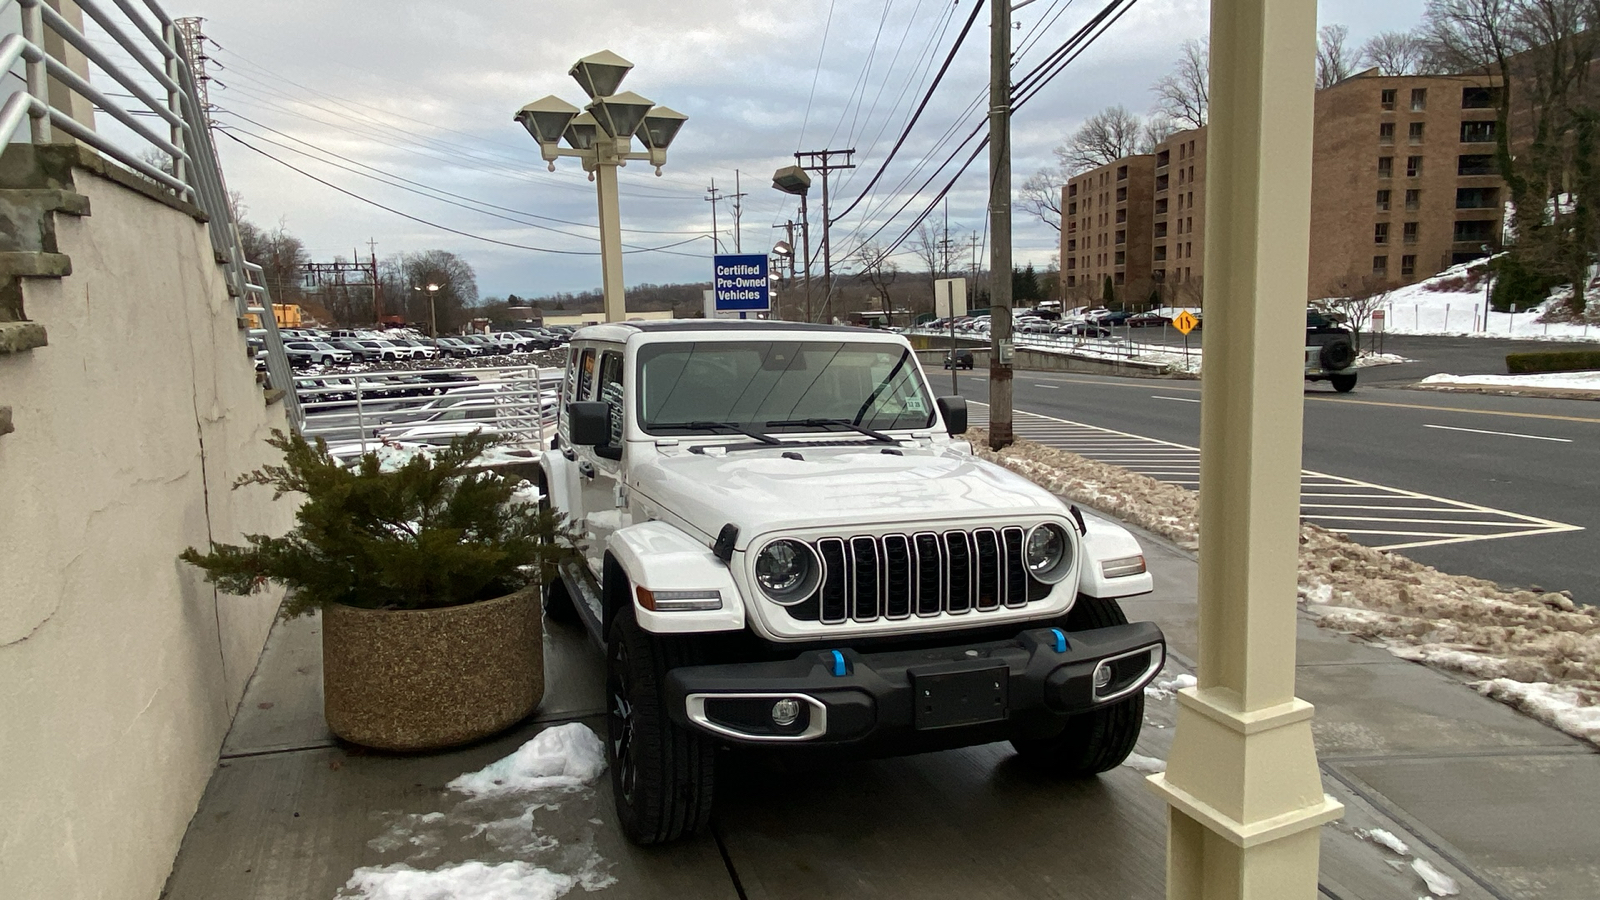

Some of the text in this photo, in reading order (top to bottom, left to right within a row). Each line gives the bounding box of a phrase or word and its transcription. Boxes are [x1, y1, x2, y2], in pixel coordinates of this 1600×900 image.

[717, 264, 760, 276] Certified
[717, 277, 766, 288] Pre-Owned
[718, 290, 760, 301] Vehicles
